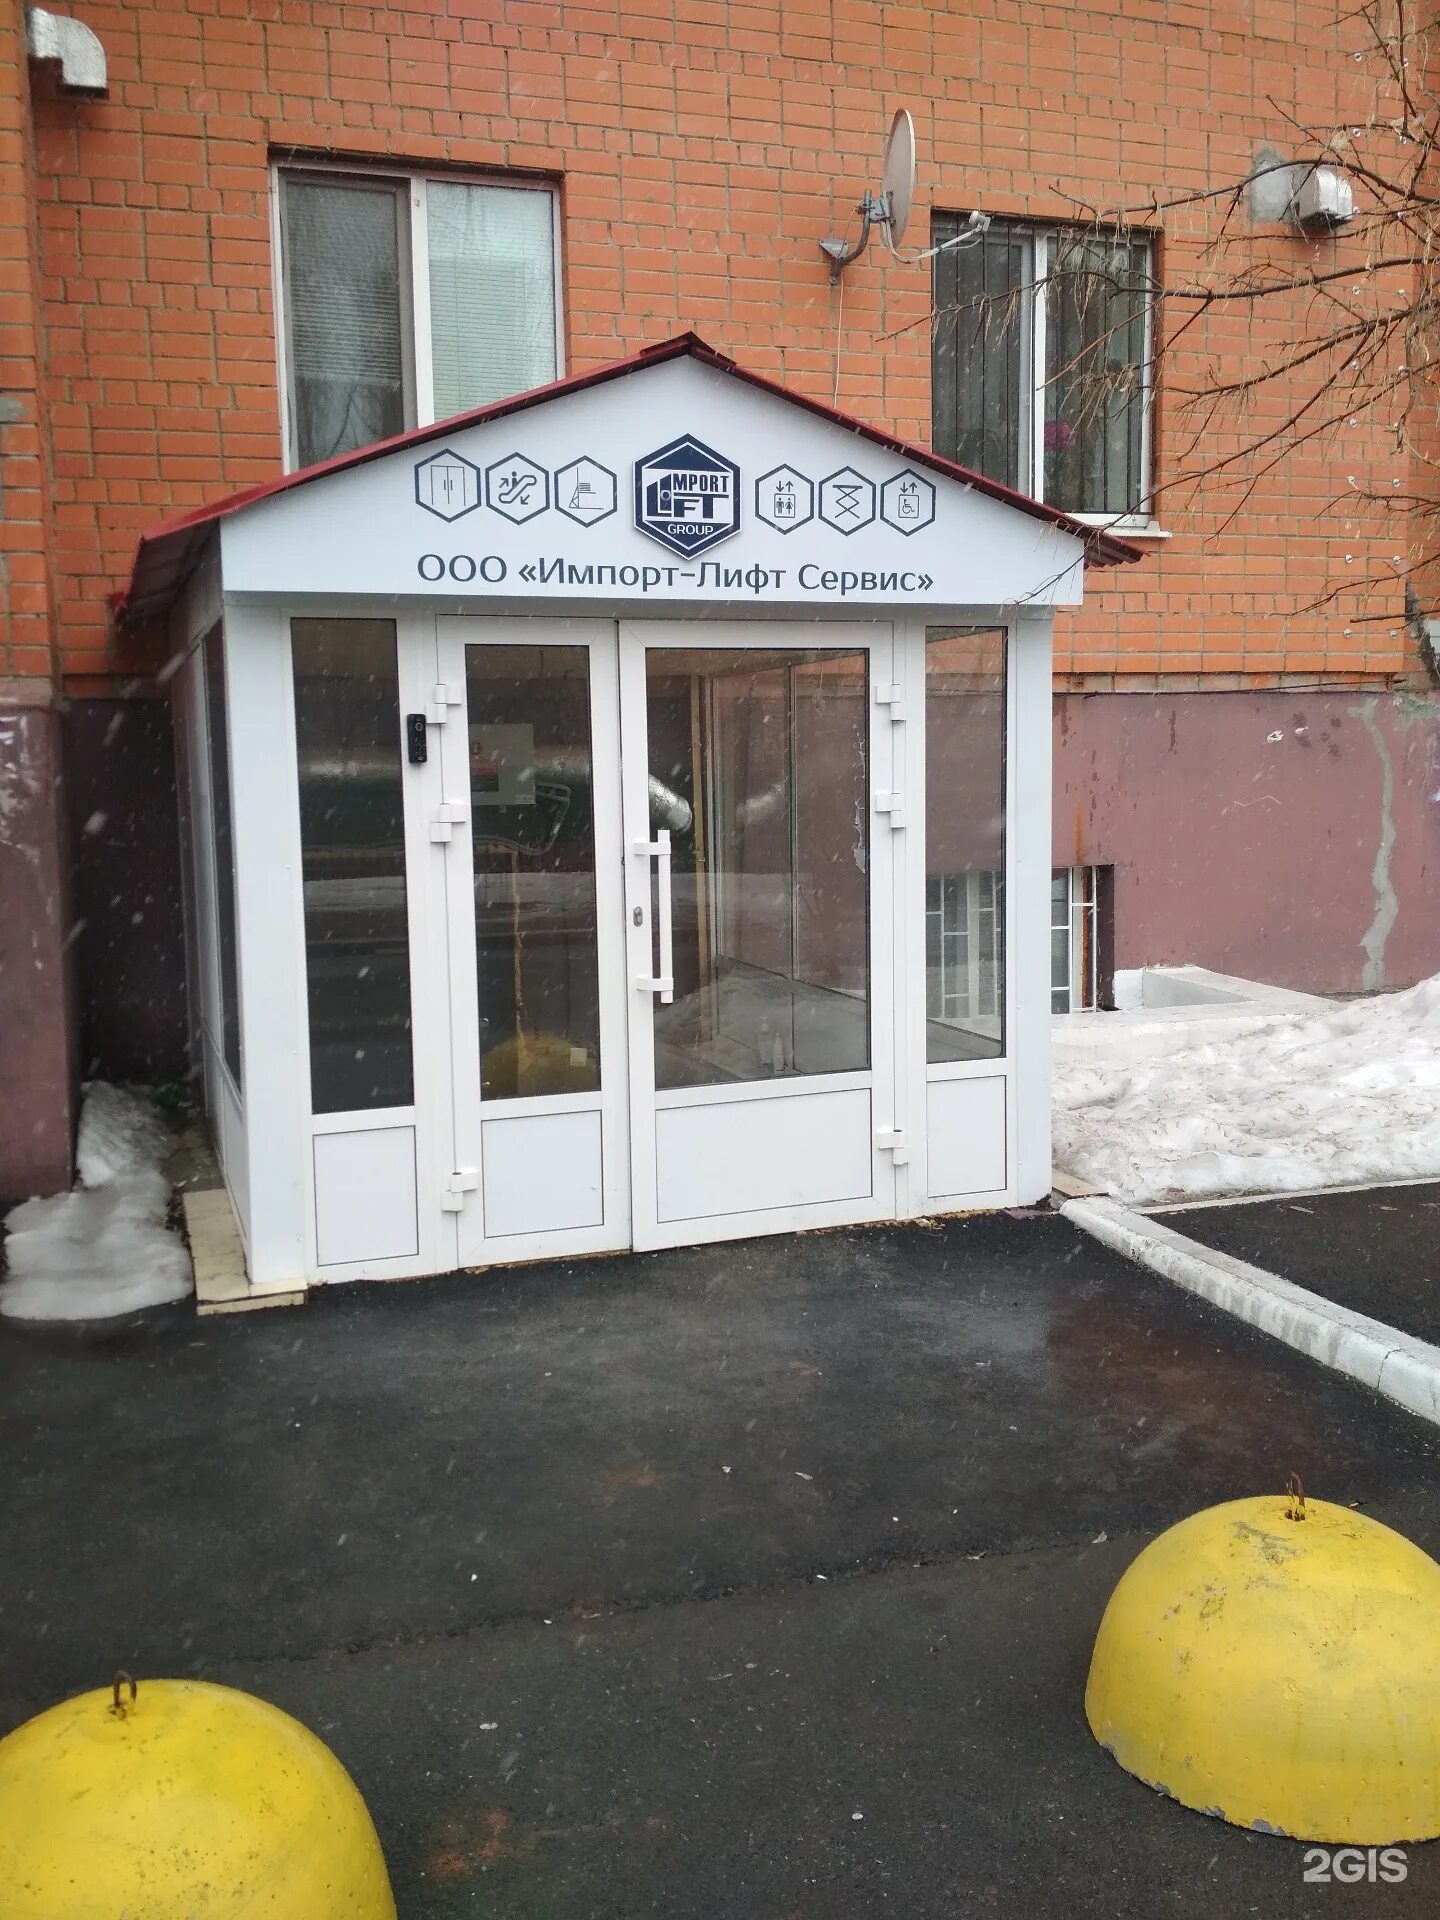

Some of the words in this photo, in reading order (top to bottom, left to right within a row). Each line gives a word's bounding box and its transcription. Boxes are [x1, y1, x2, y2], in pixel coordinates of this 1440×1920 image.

[667, 523, 714, 536] GROUP
[417, 554, 507, 583] ООО
[518, 557, 786, 595] «Импорт-Лифт
[798, 563, 934, 596] Сервис»
